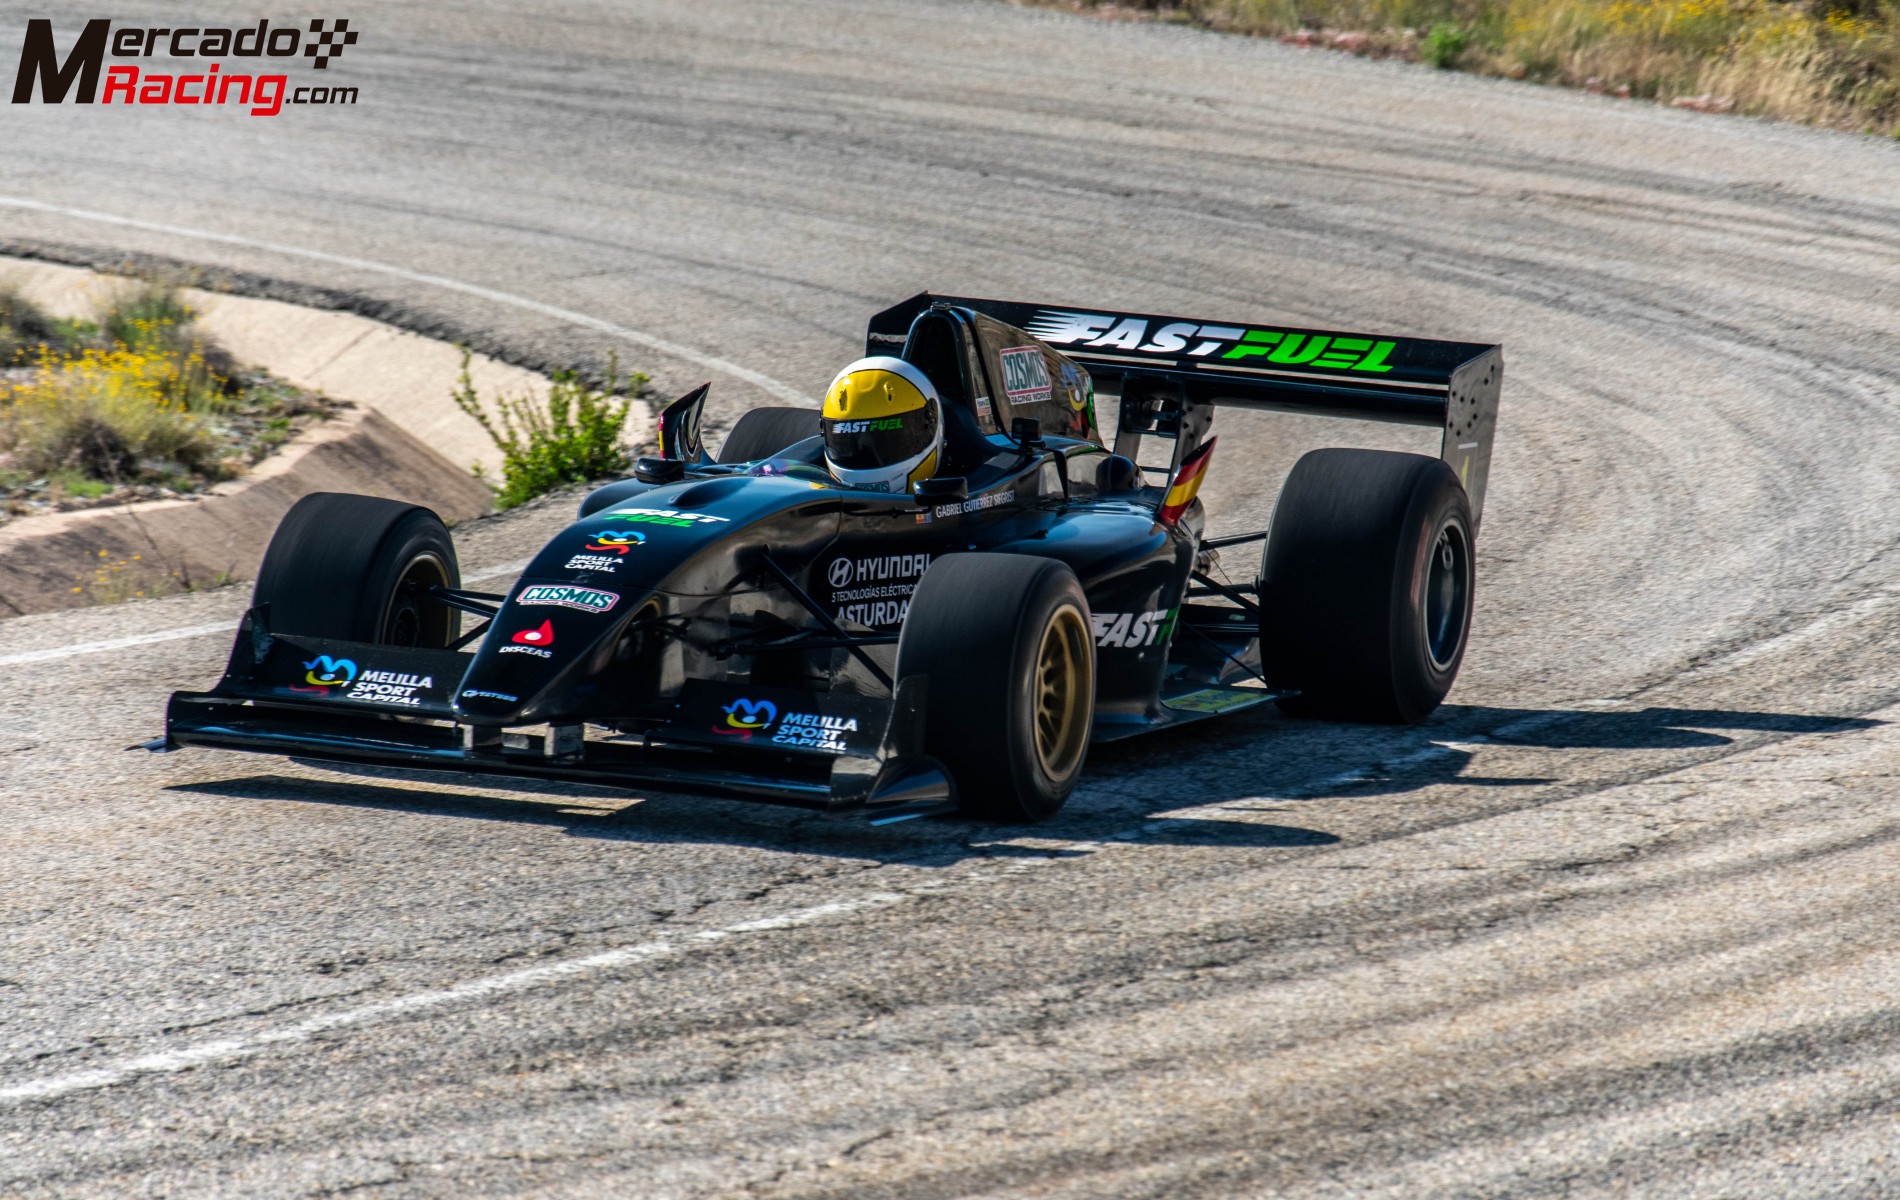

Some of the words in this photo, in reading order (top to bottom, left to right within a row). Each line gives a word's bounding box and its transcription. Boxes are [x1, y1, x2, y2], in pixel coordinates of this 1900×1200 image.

[1002, 351, 1050, 392] COSMOS
[1011, 394, 1032, 404] RACING
[1033, 391, 1051, 401] WORKS
[936, 503, 962, 518] GABRIEL
[603, 514, 695, 528] FUEL
[571, 555, 623, 564] MELILLA
[564, 564, 616, 572] CAPITAL
[522, 587, 614, 608] COSMOS
[837, 585, 880, 602] TECNOLOGÍAS
[359, 670, 433, 688] MELILLA
[352, 682, 417, 696] SPORT
[346, 691, 421, 705] CAPITAL
[782, 712, 858, 731] MELILLA
[777, 724, 842, 740] SPORT
[771, 735, 847, 751] CAPITAL
